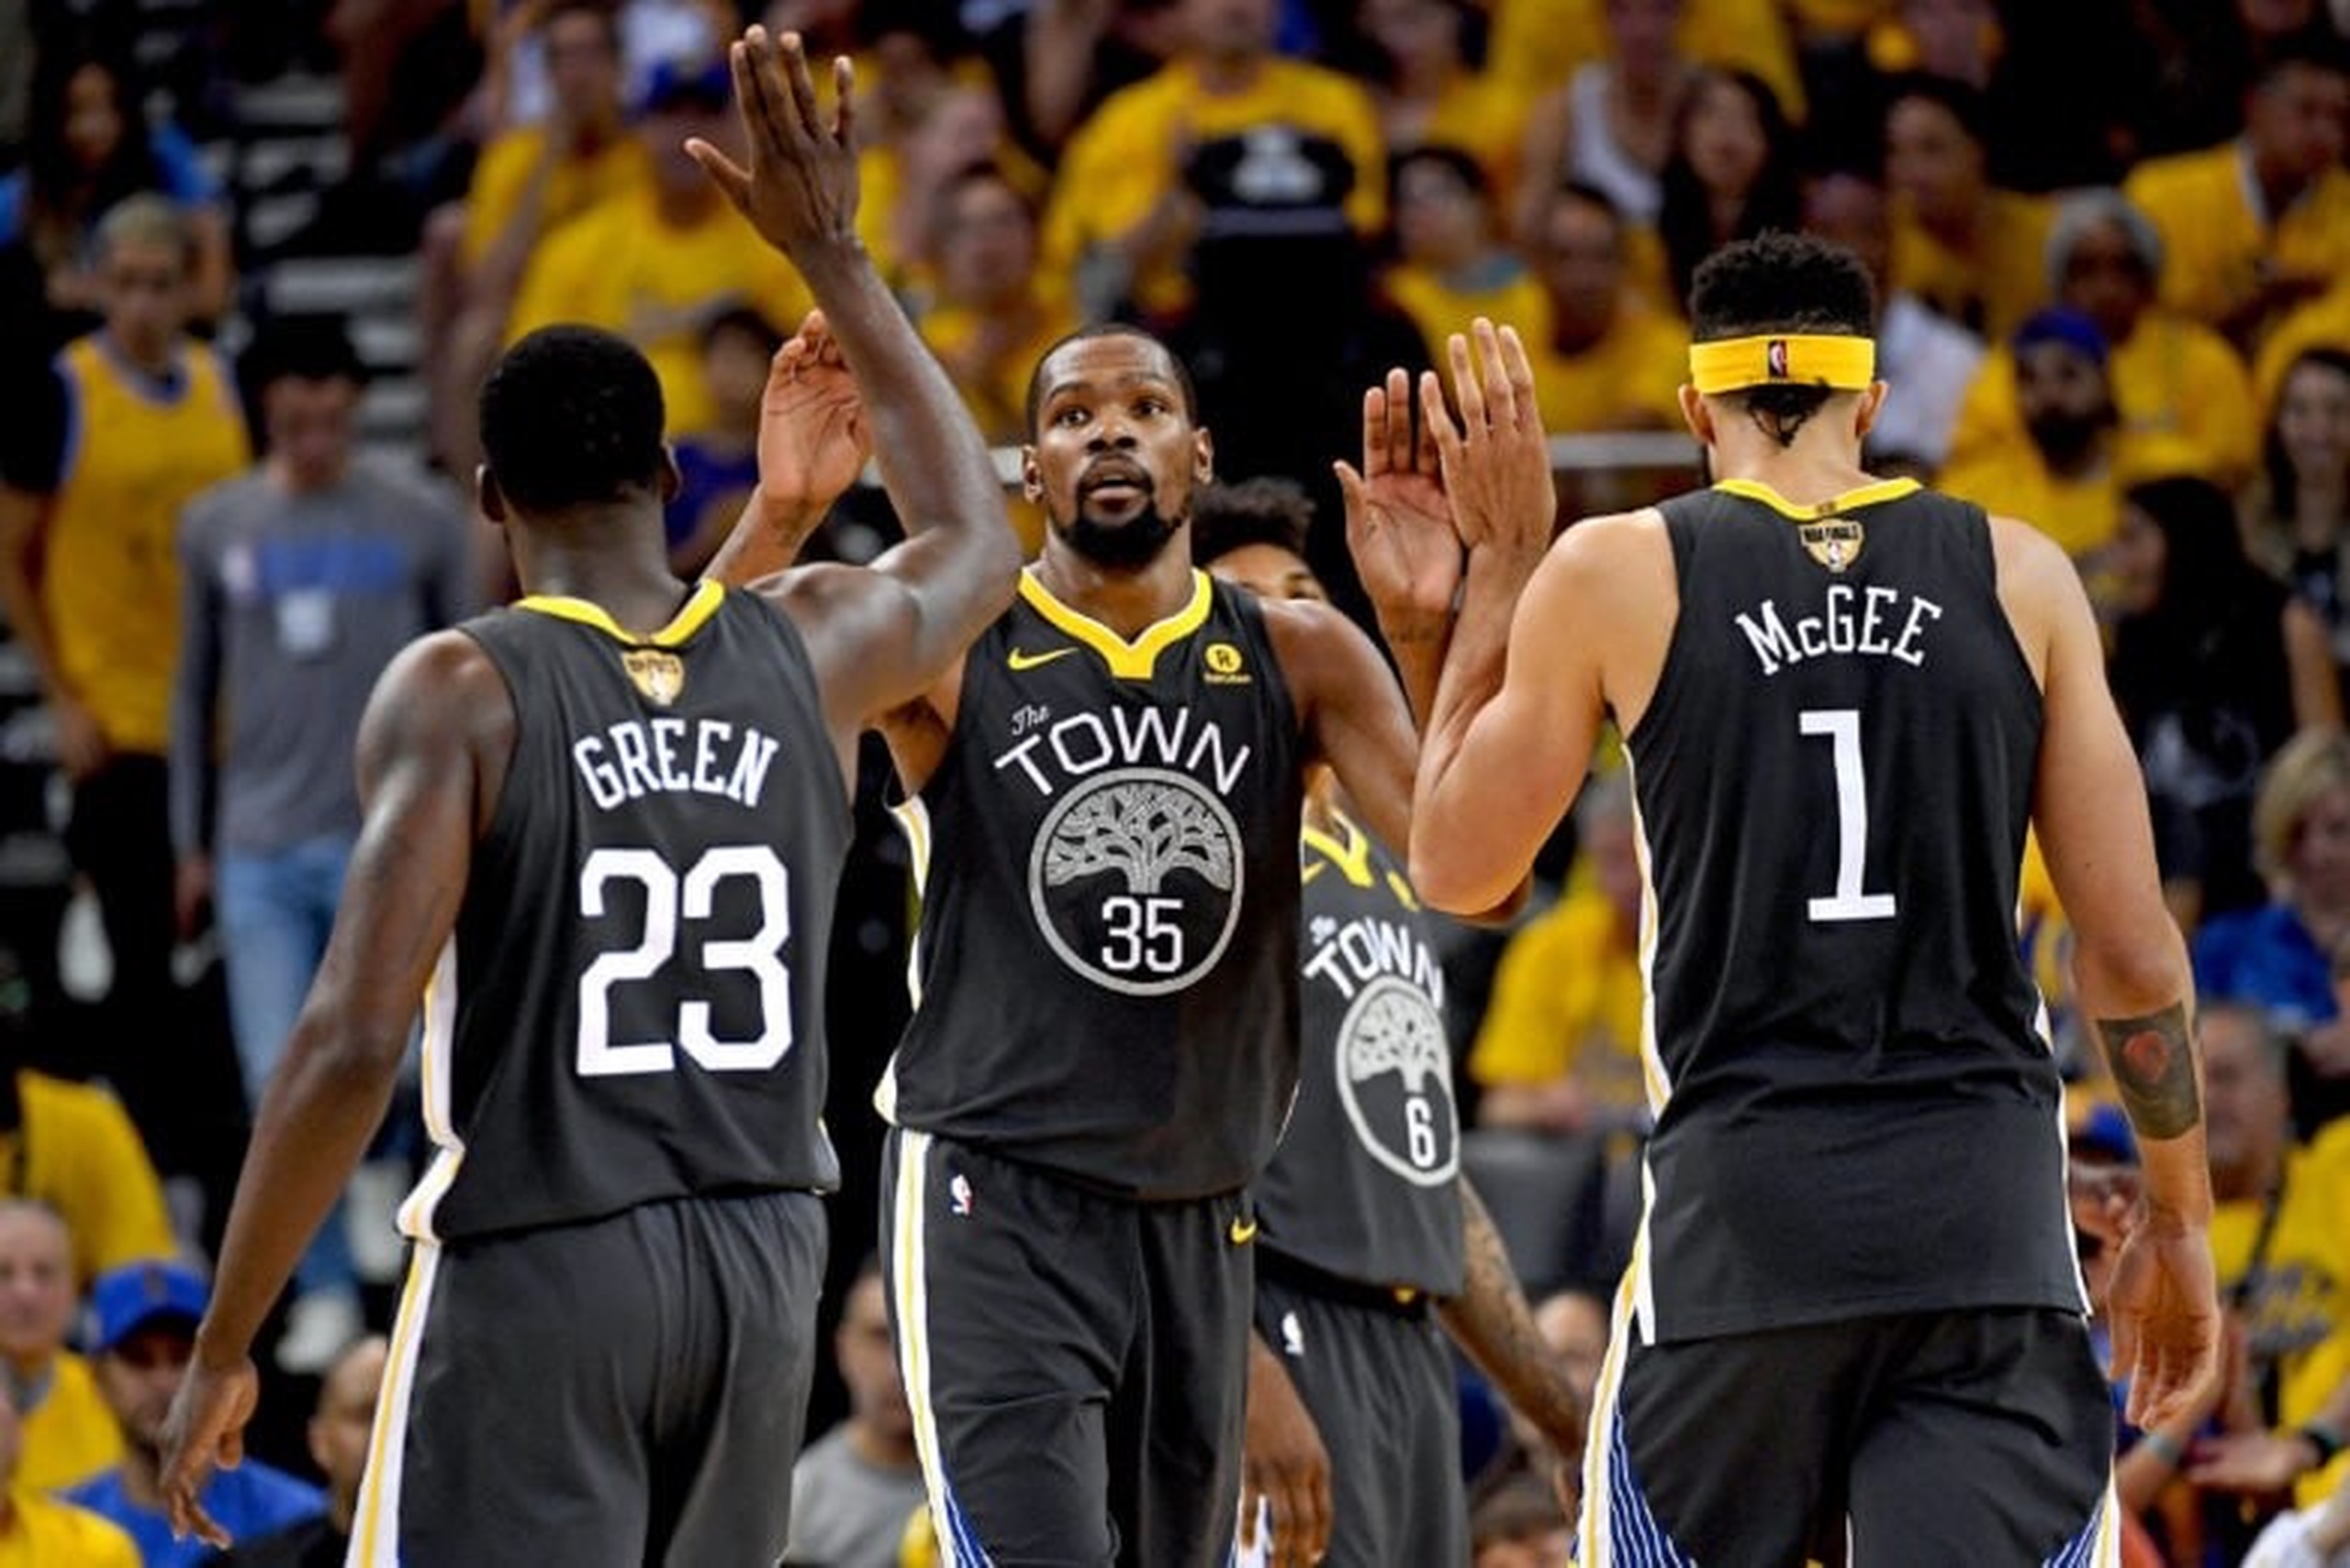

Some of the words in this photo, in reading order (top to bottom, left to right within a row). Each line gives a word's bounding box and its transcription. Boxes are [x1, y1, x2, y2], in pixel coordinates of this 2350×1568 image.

[1734, 585, 1942, 676] McGEE
[573, 718, 778, 810] GREEN
[994, 706, 1251, 796] TOWN
[1011, 704, 1050, 735] The
[1799, 710, 1896, 921] 1
[576, 845, 792, 1076] 23
[1102, 896, 1183, 972] 35
[1303, 916, 1443, 1010] TOWN
[1405, 1097, 1436, 1168] 6
